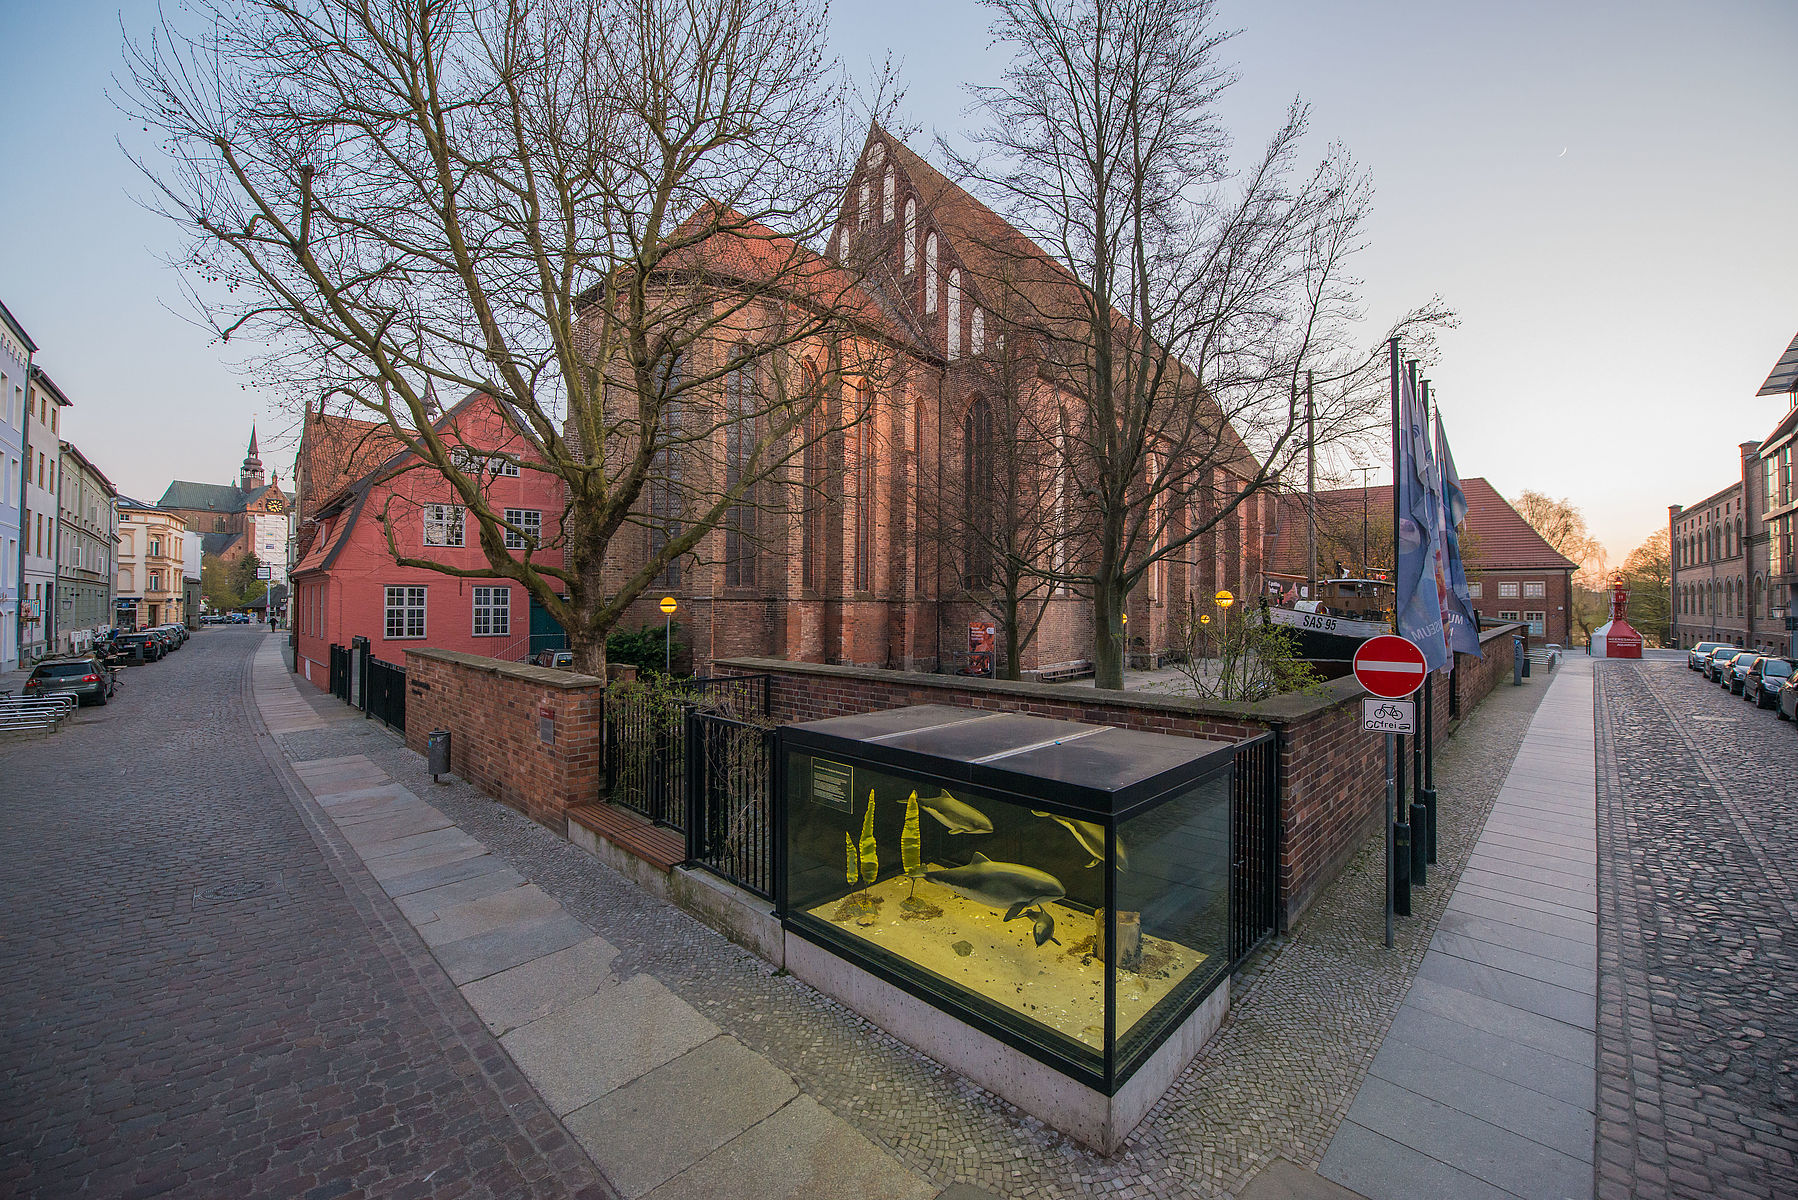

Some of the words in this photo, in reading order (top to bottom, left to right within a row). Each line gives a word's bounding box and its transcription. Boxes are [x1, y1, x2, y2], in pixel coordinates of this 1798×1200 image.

[1303, 615, 1324, 629] SAS
[1325, 619, 1338, 631] 95
[1380, 720, 1397, 729] frei
